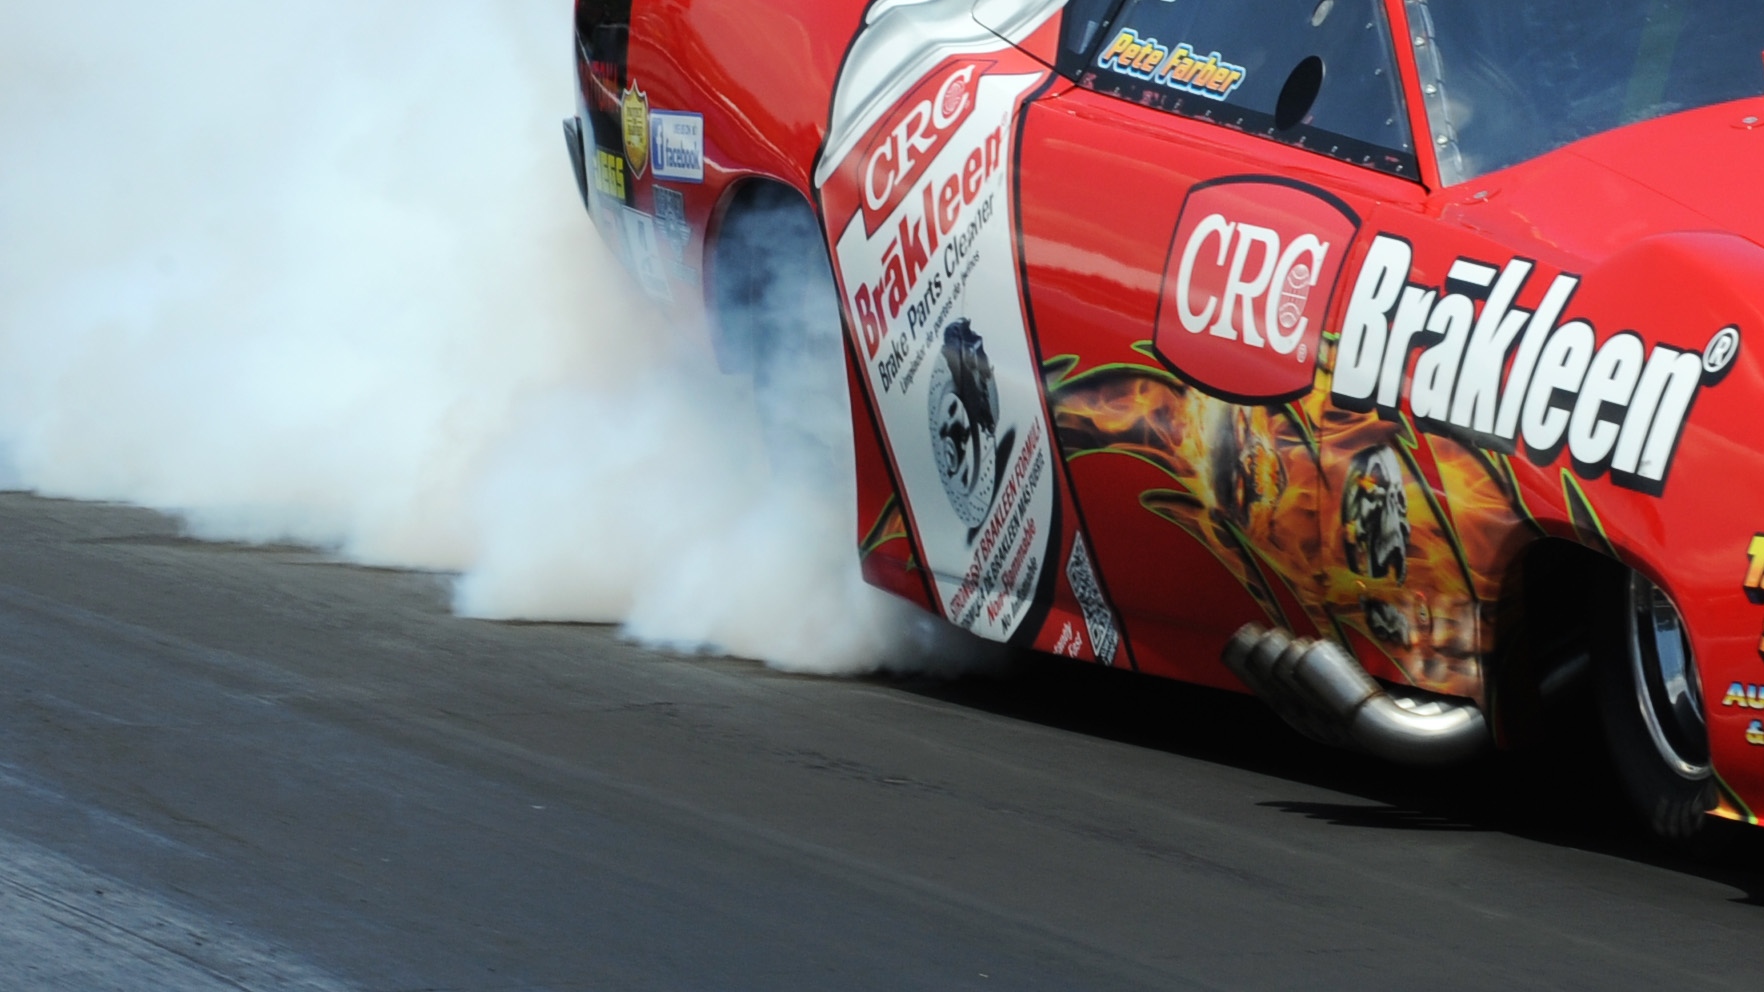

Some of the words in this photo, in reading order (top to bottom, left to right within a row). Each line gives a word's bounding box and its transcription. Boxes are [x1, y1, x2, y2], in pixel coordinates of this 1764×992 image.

[1101, 30, 1166, 77] Pete
[1158, 45, 1243, 98] Farber
[865, 64, 975, 211] CRC
[878, 332, 909, 394] Brake
[907, 272, 942, 340] Parts
[1176, 213, 1330, 356] CRC
